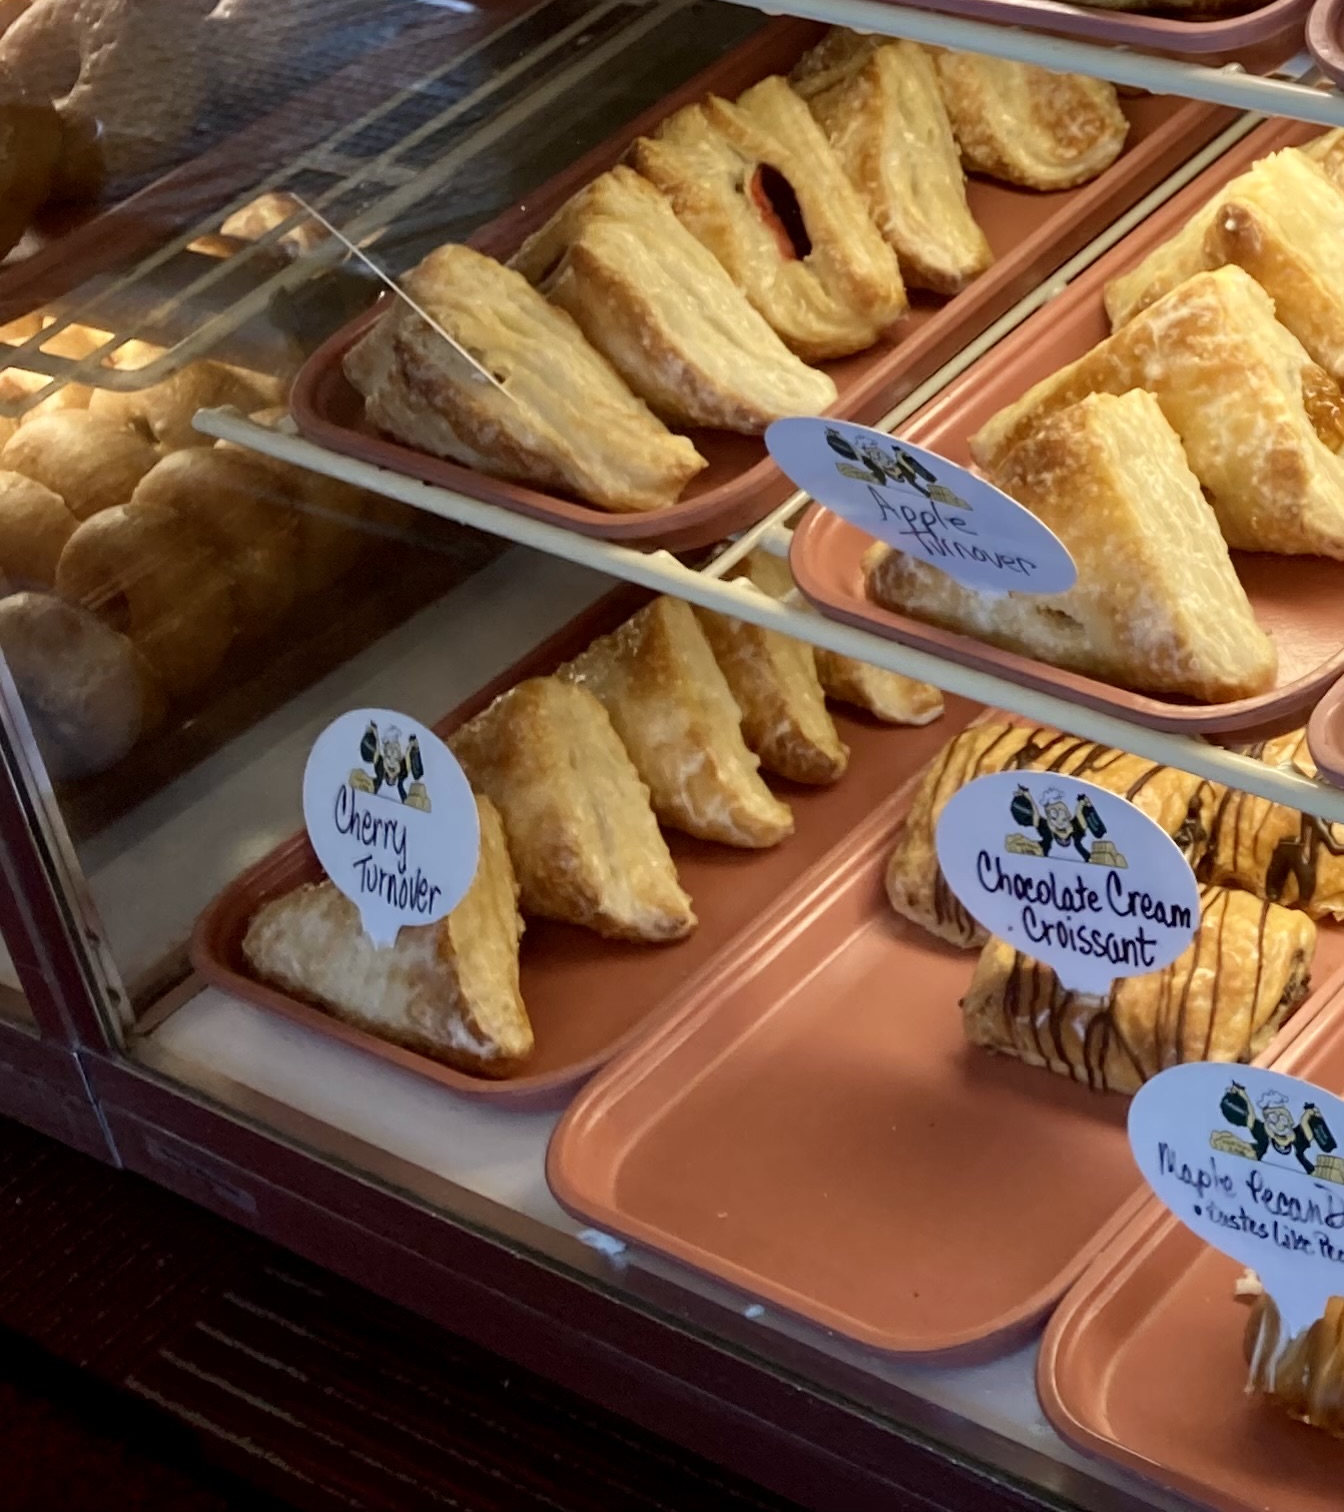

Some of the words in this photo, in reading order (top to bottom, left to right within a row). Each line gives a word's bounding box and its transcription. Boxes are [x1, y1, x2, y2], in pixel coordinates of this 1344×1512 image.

[866, 484, 979, 538] Apple
[898, 530, 1038, 577] Turnover
[334, 784, 407, 875] Cherry
[352, 854, 442, 916] Turnover
[976, 849, 1103, 914] Chocolate
[1105, 870, 1192, 929] Cream
[1021, 905, 1158, 968] Croissant
[1157, 1141, 1237, 1199] Maple
[1245, 1168, 1324, 1227] Pecan
